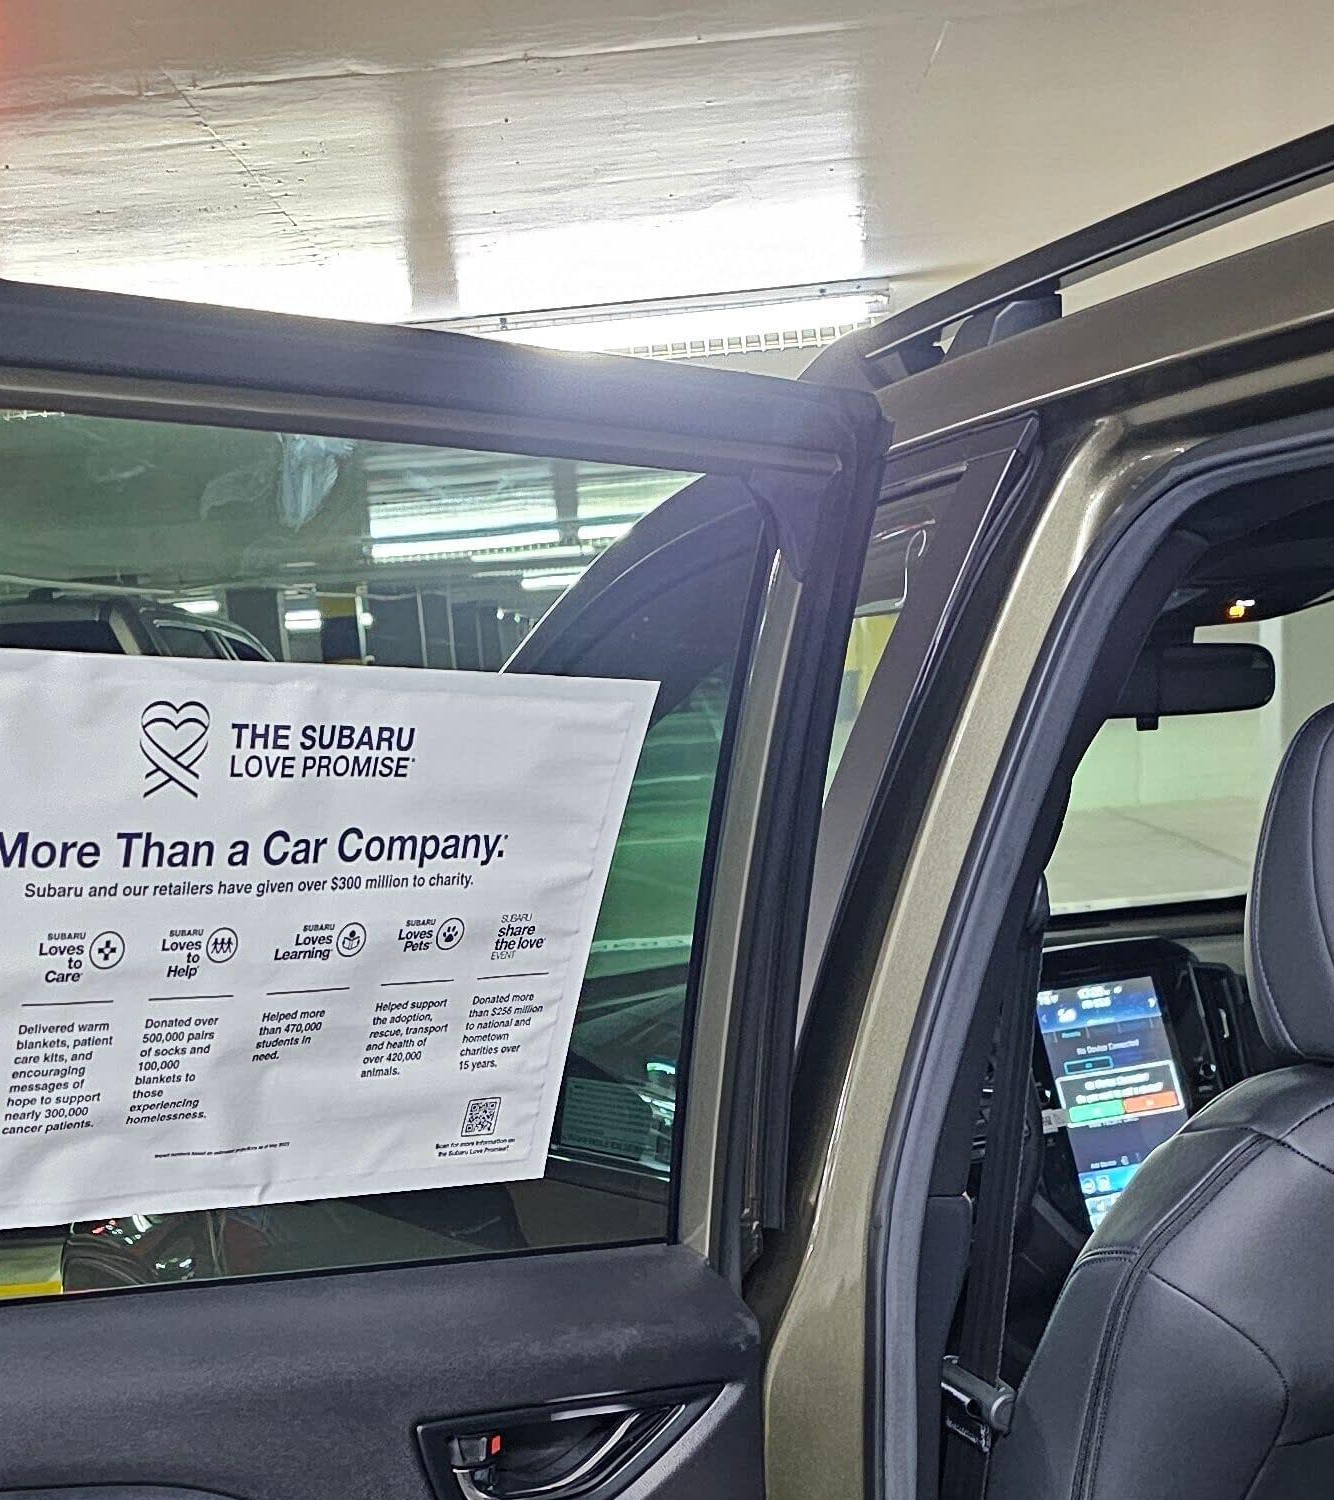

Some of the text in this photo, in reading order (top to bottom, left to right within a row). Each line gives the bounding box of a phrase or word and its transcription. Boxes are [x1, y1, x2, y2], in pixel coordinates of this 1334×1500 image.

[231, 722, 416, 752] THE SUBARU
[229, 755, 297, 779] LOVE
[117, 831, 215, 867] Than
[228, 840, 249, 867] a
[263, 831, 328, 866] Car
[24, 872, 474, 898] Subaru and our retailers have given over $300 million to charity.
[302, 923, 336, 932] SUBARU
[405, 918, 437, 927] SUBARU
[47, 932, 87, 941] SUBARU
[169, 929, 204, 938] SUBARU
[397, 928, 434, 941] Loves
[497, 923, 536, 937] share
[161, 938, 202, 952] Loves
[294, 933, 333, 947] Loves
[403, 940, 431, 952] Pets
[494, 937, 545, 951] the love
[38, 942, 85, 957] Loves
[273, 947, 331, 961] Learning
[490, 950, 516, 961] EVENT
[67, 957, 83, 970] to
[186, 952, 201, 964] to
[44, 970, 82, 983] Care
[166, 965, 198, 980] Help
[375, 998, 448, 1014] Helped support
[472, 993, 535, 1006] Donated more
[261, 1009, 326, 1024] Helped more
[468, 1007, 490, 1018] than
[513, 1003, 544, 1015] million
[144, 1017, 219, 1029] Donated over
[372, 1012, 433, 1026] the adoption,
[465, 1016, 532, 1031] to national and
[18, 1022, 110, 1036] Delivered warm
[258, 1021, 323, 1037] than 470,000
[369, 1023, 449, 1039] rescue, transport
[16, 1035, 113, 1051] blankets, patient
[142, 1030, 215, 1044] 500,000 pairs
[255, 1035, 312, 1049] students in
[461, 1031, 510, 1044] hometown
[139, 1044, 211, 1058] of socks and
[365, 1037, 428, 1052] and health of
[459, 1044, 521, 1057] charities over
[13, 1051, 93, 1065] care kits, and
[252, 1050, 280, 1062] need.
[362, 1050, 422, 1065] over 420,000
[11, 1066, 86, 1079] encouraging
[138, 1059, 180, 1072] 100,000
[360, 1066, 400, 1078] animals.
[459, 1059, 497, 1072] 15 years.
[134, 1072, 196, 1086] blankets to
[8, 1079, 85, 1094] messages of
[6, 1092, 101, 1109] hope to support
[132, 1089, 164, 1100] those
[129, 1098, 200, 1114] experiencing
[4, 1106, 89, 1122] nearly 300,000
[125, 1110, 206, 1125] homelessness.
[1, 1120, 94, 1135] cancer patients.
